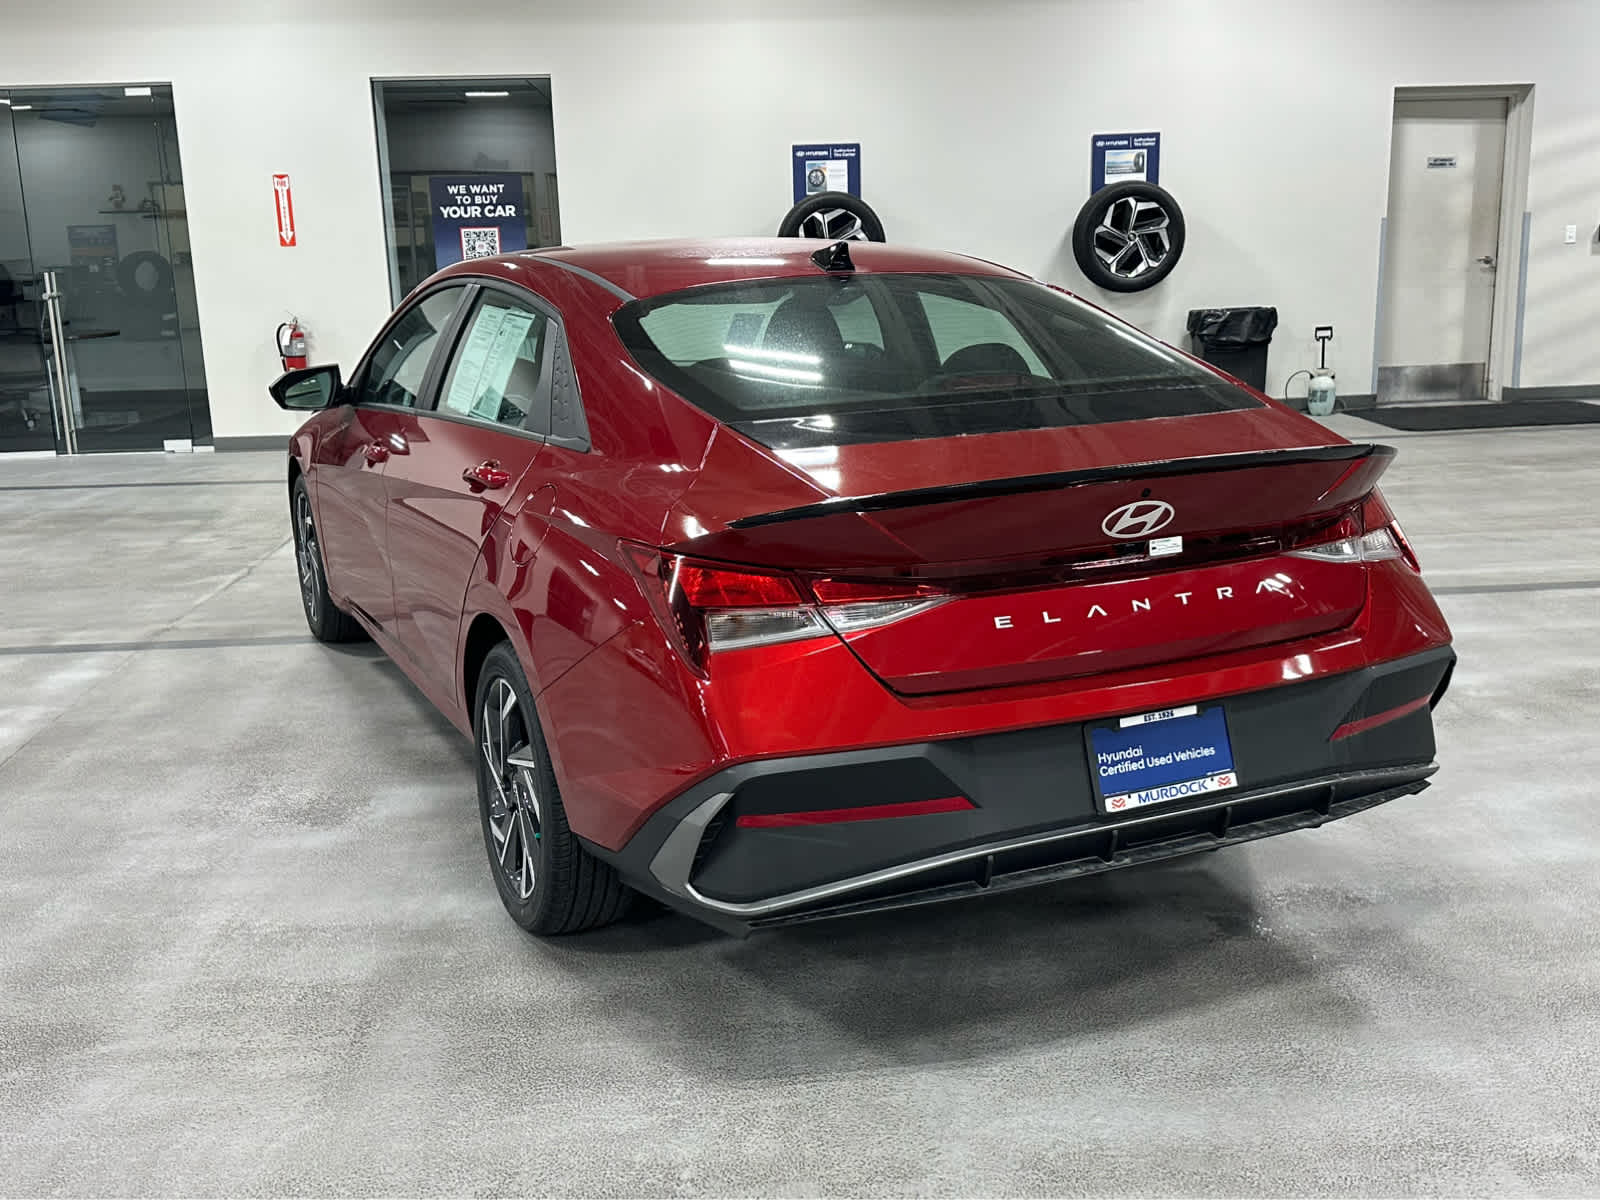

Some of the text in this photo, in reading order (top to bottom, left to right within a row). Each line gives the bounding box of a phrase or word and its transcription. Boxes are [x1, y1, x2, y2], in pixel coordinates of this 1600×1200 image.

[447, 184, 505, 194] WE WANT
[455, 194, 498, 205] TO BUY
[440, 204, 516, 219] YOUR CAR
[994, 578, 1278, 629] ELANTRA
[1097, 745, 1143, 764] Hyundai
[1099, 745, 1216, 777] Certified Used Vehicles
[1138, 780, 1209, 805] MURDOCK
